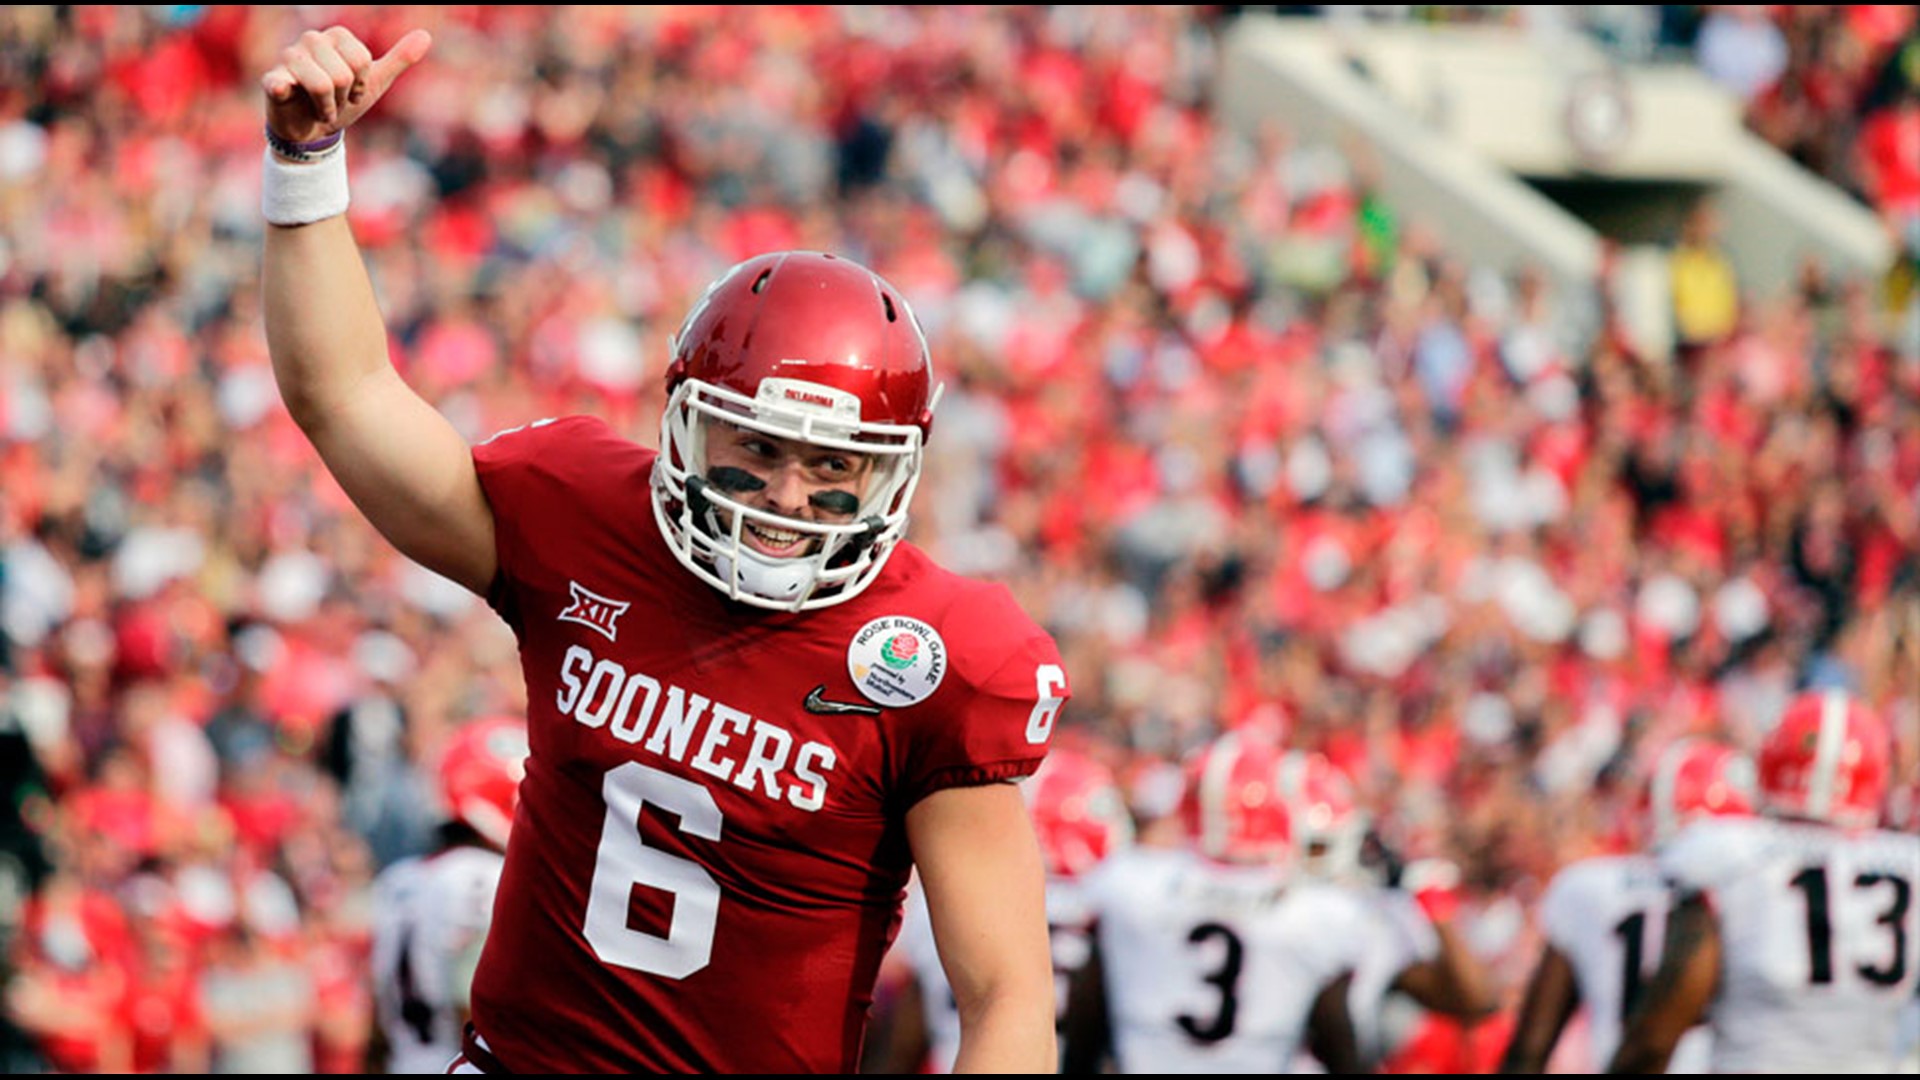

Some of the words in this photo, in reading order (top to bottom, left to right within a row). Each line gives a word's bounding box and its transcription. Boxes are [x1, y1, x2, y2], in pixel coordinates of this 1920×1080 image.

[784, 388, 834, 408] OKLAHOMA
[857, 619, 891, 646] ROSE
[894, 618, 930, 641] BOWL
[925, 640, 942, 685] GAME
[1025, 664, 1066, 744] 6
[556, 644, 837, 812] SOONERS
[582, 760, 723, 981] 6
[1789, 866, 1912, 986] 13
[1175, 922, 1244, 1043] 3
